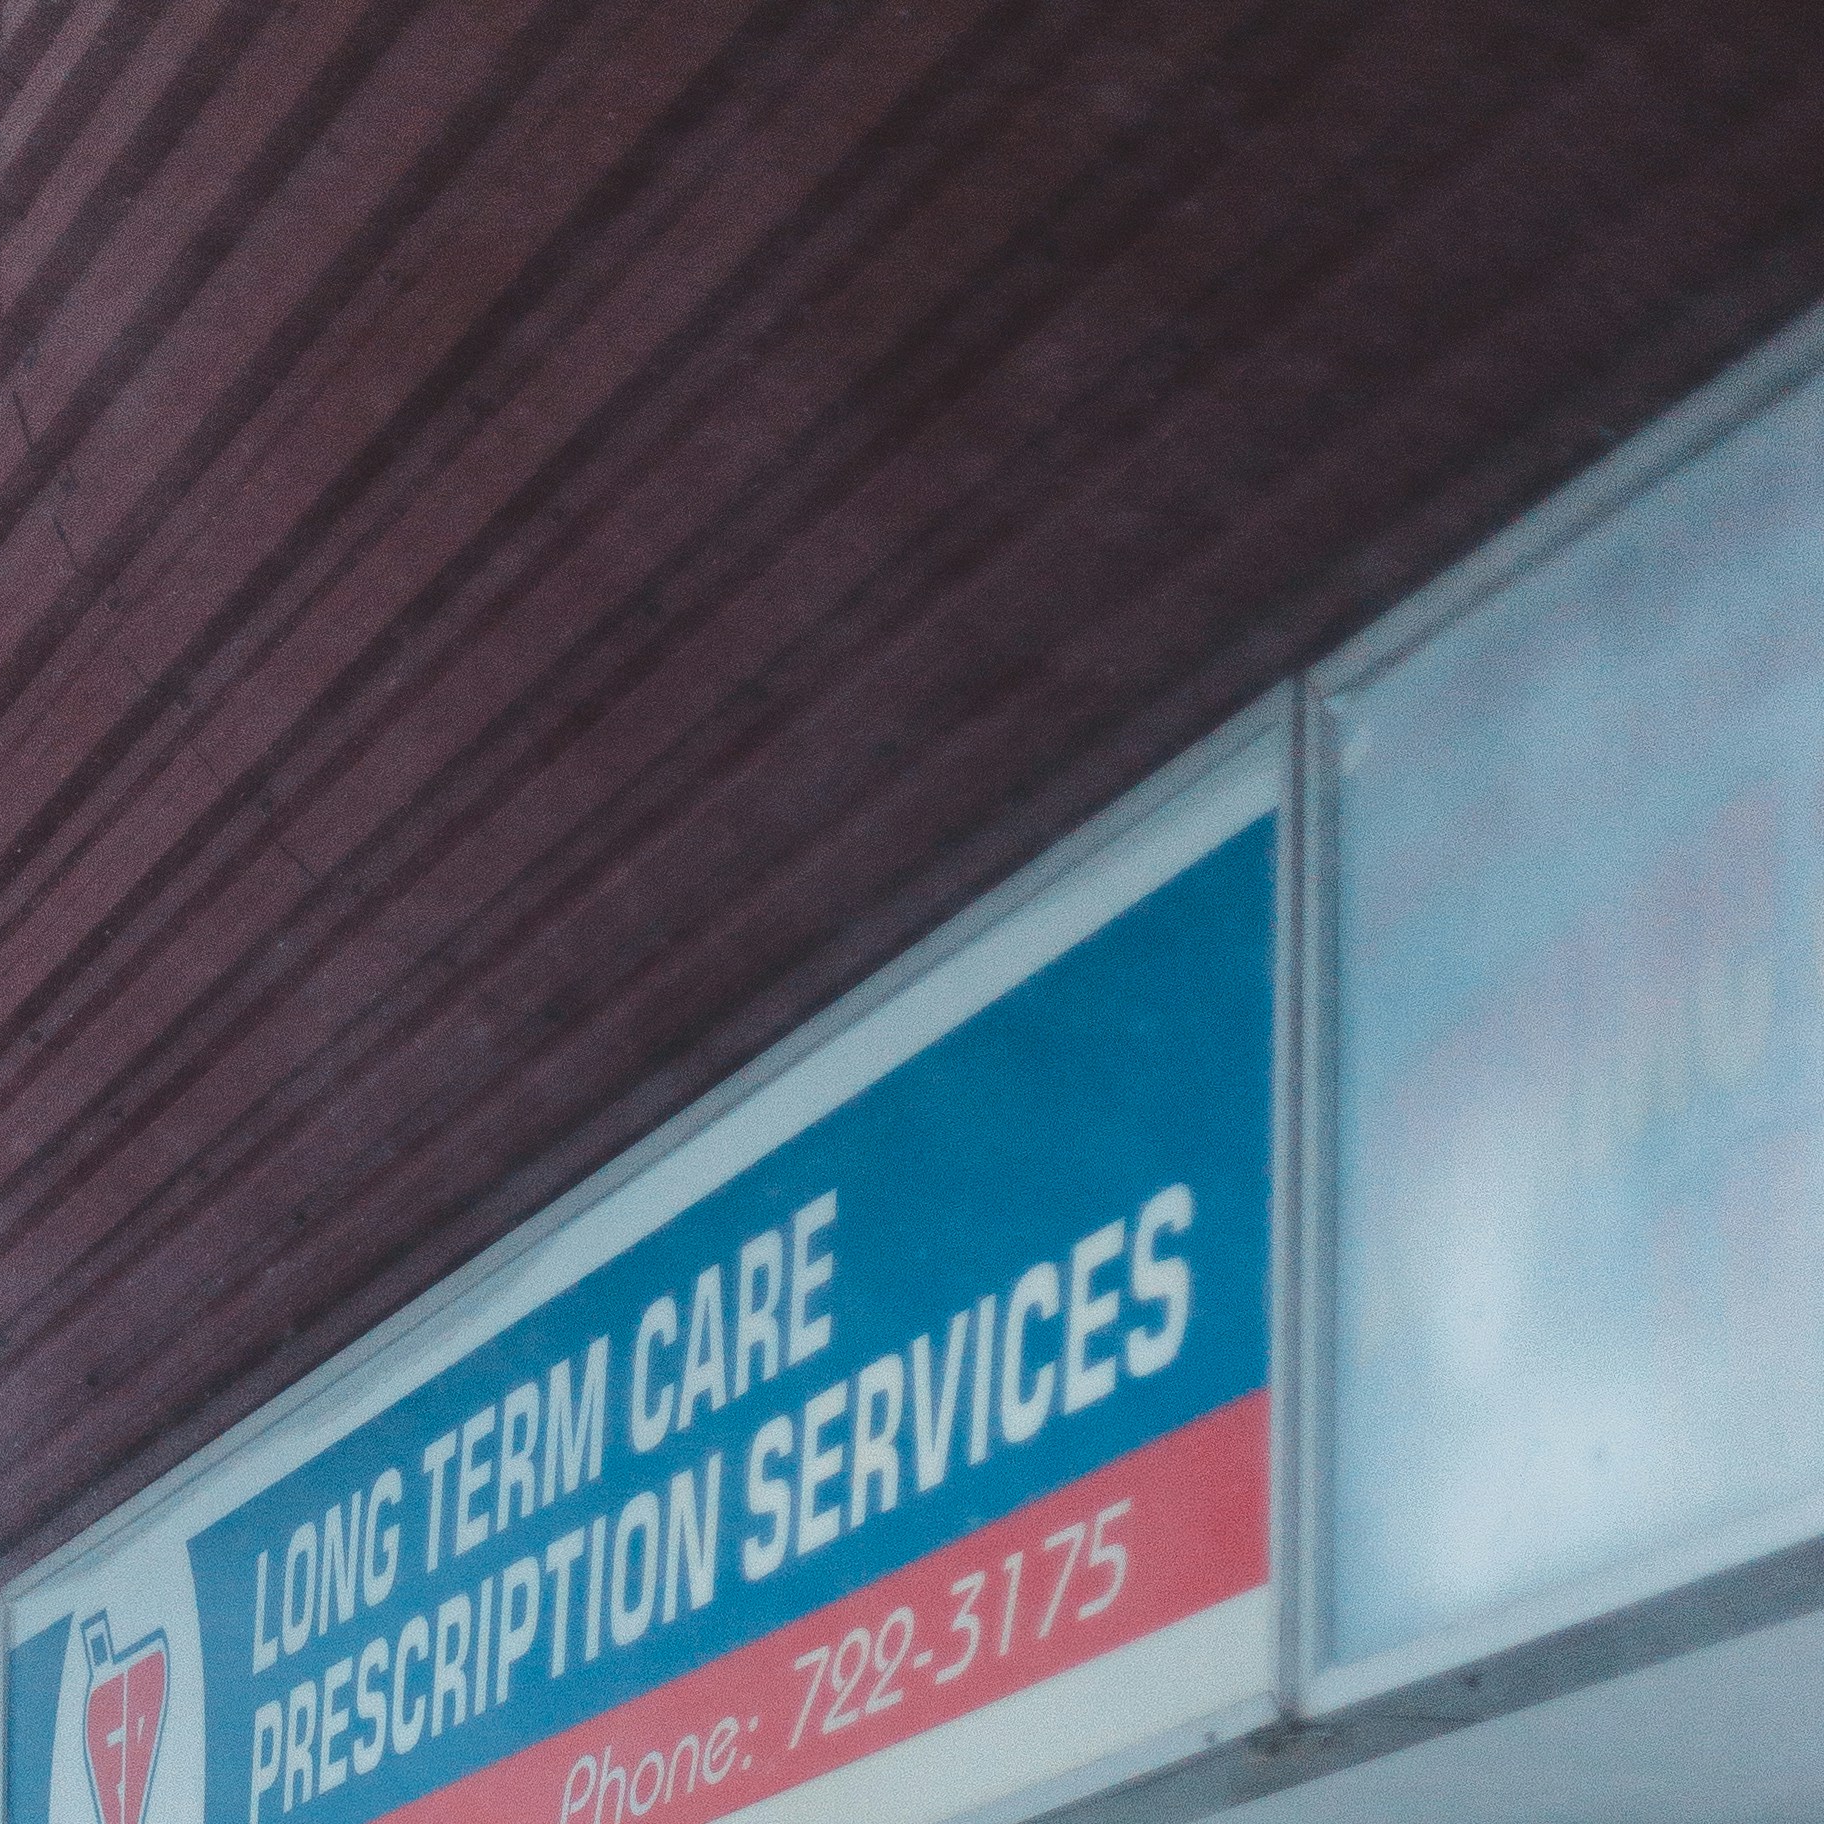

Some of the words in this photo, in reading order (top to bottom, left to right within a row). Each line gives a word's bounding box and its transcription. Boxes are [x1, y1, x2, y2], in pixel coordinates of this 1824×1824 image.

[253, 1468, 402, 1675] LONG
[423, 1334, 609, 1572] TERM
[632, 1187, 838, 1453] CARE
[743, 1183, 1195, 1581] SERVICES
[790, 1499, 1133, 1750] 722-3175
